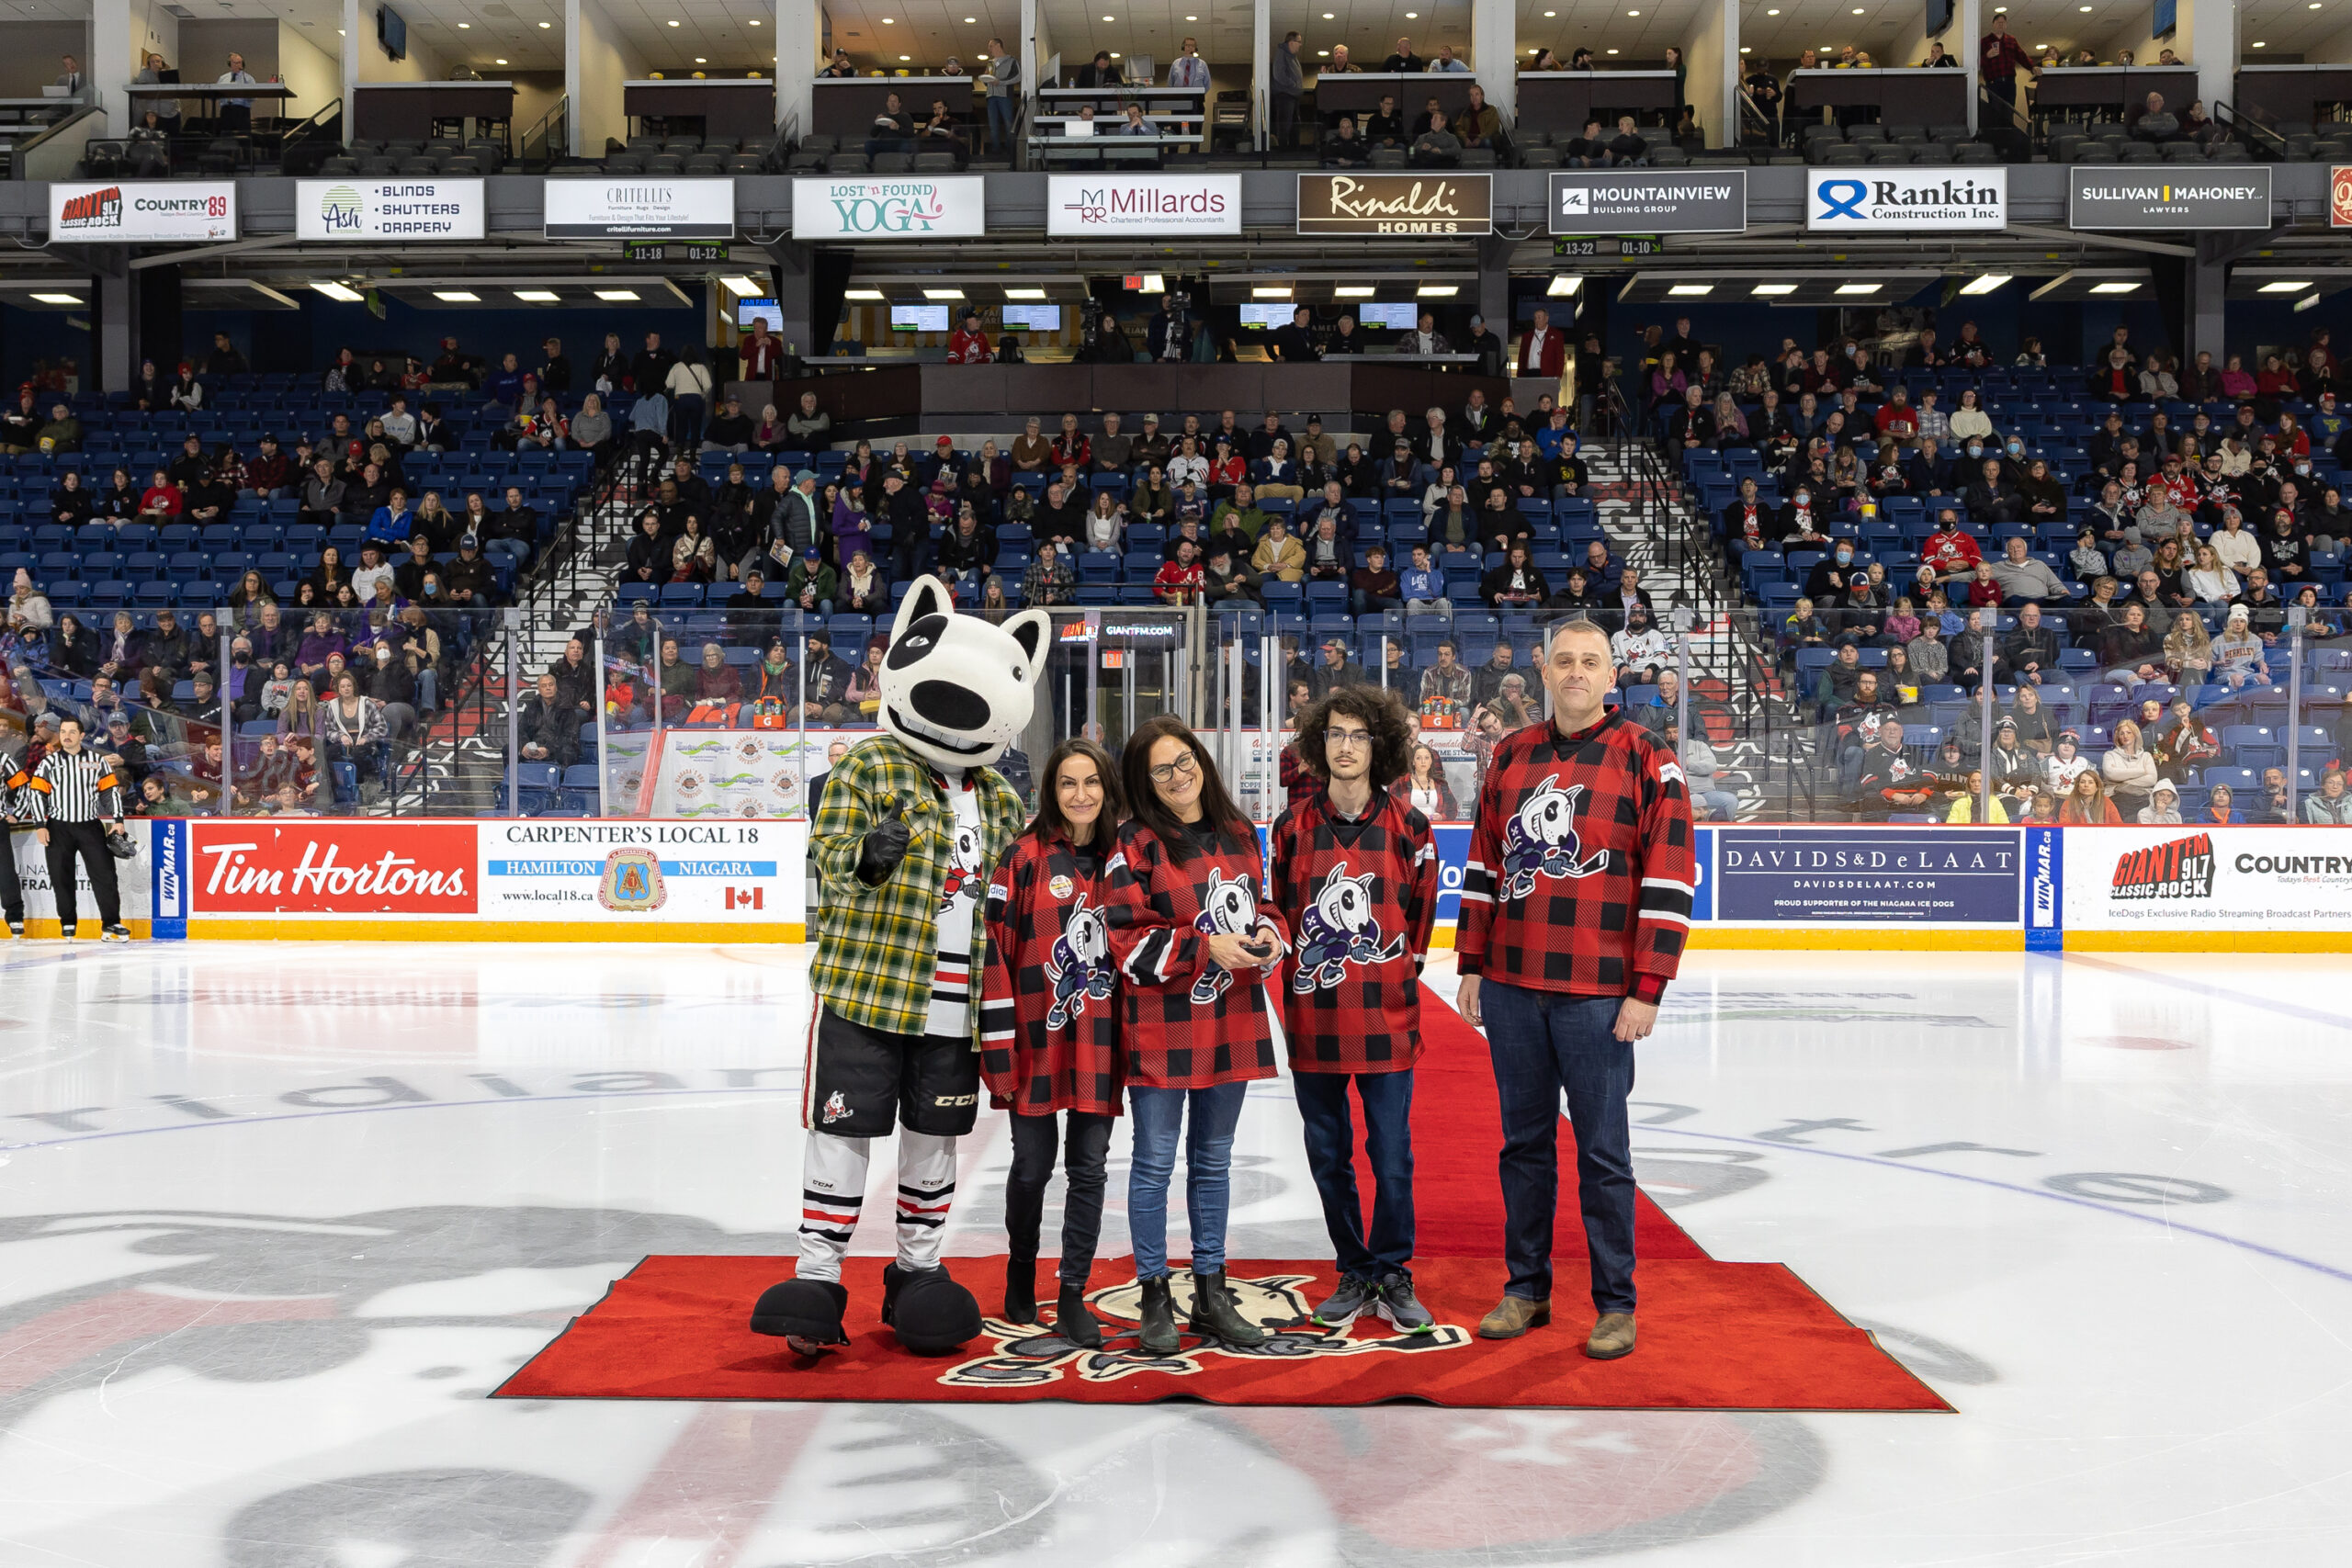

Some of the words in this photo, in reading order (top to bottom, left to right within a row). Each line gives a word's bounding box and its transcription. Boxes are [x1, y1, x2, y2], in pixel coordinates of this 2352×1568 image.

[382, 186, 435, 197] BLINDS
[606, 187, 673, 203] CRITELLI'S
[831, 185, 865, 197] LOST
[882, 184, 933, 197] FOUND
[1330, 175, 1459, 218] Rinaldi
[1593, 186, 1731, 201] MOUNTAINVIEW
[1871, 179, 1999, 206] Rankin
[2082, 187, 2158, 200] SULLIVAN
[2175, 187, 2256, 199] MAHONEY
[62, 189, 104, 220] GIANT
[104, 186, 119, 201] FM
[102, 199, 120, 215] 91.7
[209, 196, 226, 217] 89
[1112, 188, 1225, 213] Millards
[382, 204, 460, 215] SHUTTERS
[831, 197, 934, 232] YOGA
[1871, 208, 1966, 219] Construction
[1971, 208, 1999, 219] Inc.
[60, 218, 87, 228] CLASSIC
[87, 215, 120, 227] ROCK
[322, 203, 362, 233] Ash
[616, 214, 634, 222] Design
[382, 221, 452, 233] DRAPERY
[1378, 222, 1458, 233] HOMES
[635, 248, 662, 259] 11-18
[690, 247, 717, 259] 01-12
[1566, 243, 1594, 254] 13-22
[1622, 242, 1650, 254] 01-10
[1125, 276, 1142, 288] EXIT
[1106, 626, 1173, 636] GIANTFM.COM
[763, 717, 772, 726] G
[1433, 717, 1442, 726] G
[506, 826, 651, 843] CARPENTER'S
[659, 827, 730, 842] LOCAL
[738, 828, 759, 843] 18
[164, 824, 175, 900] WINMAR.ca
[2112, 839, 2185, 886] GIANT
[2185, 832, 2209, 857] FM
[202, 842, 283, 896] Tim
[291, 840, 465, 897] Hortons
[506, 861, 596, 874] HAMILTON
[679, 862, 753, 875] NIAGARA
[2038, 831, 2052, 910] WINMAR.ca
[2181, 854, 2211, 880] 91.7
[1793, 881, 1936, 889] DAVIDSDELAAT.COM
[2278, 875, 2301, 884] Todays
[2110, 883, 2155, 897] CLASSIC
[2156, 879, 2208, 897] ROCK
[503, 889, 594, 901] www.local18.ca
[2109, 909, 2144, 919] IceDogs
[2147, 908, 2188, 918] Exclusive
[2191, 909, 2216, 918] Radio
[2219, 909, 2264, 919] Streaming
[2267, 909, 2311, 918] Broadcast
[2313, 909, 2351, 918] Partners
[813, 1179, 834, 1189] CCM
